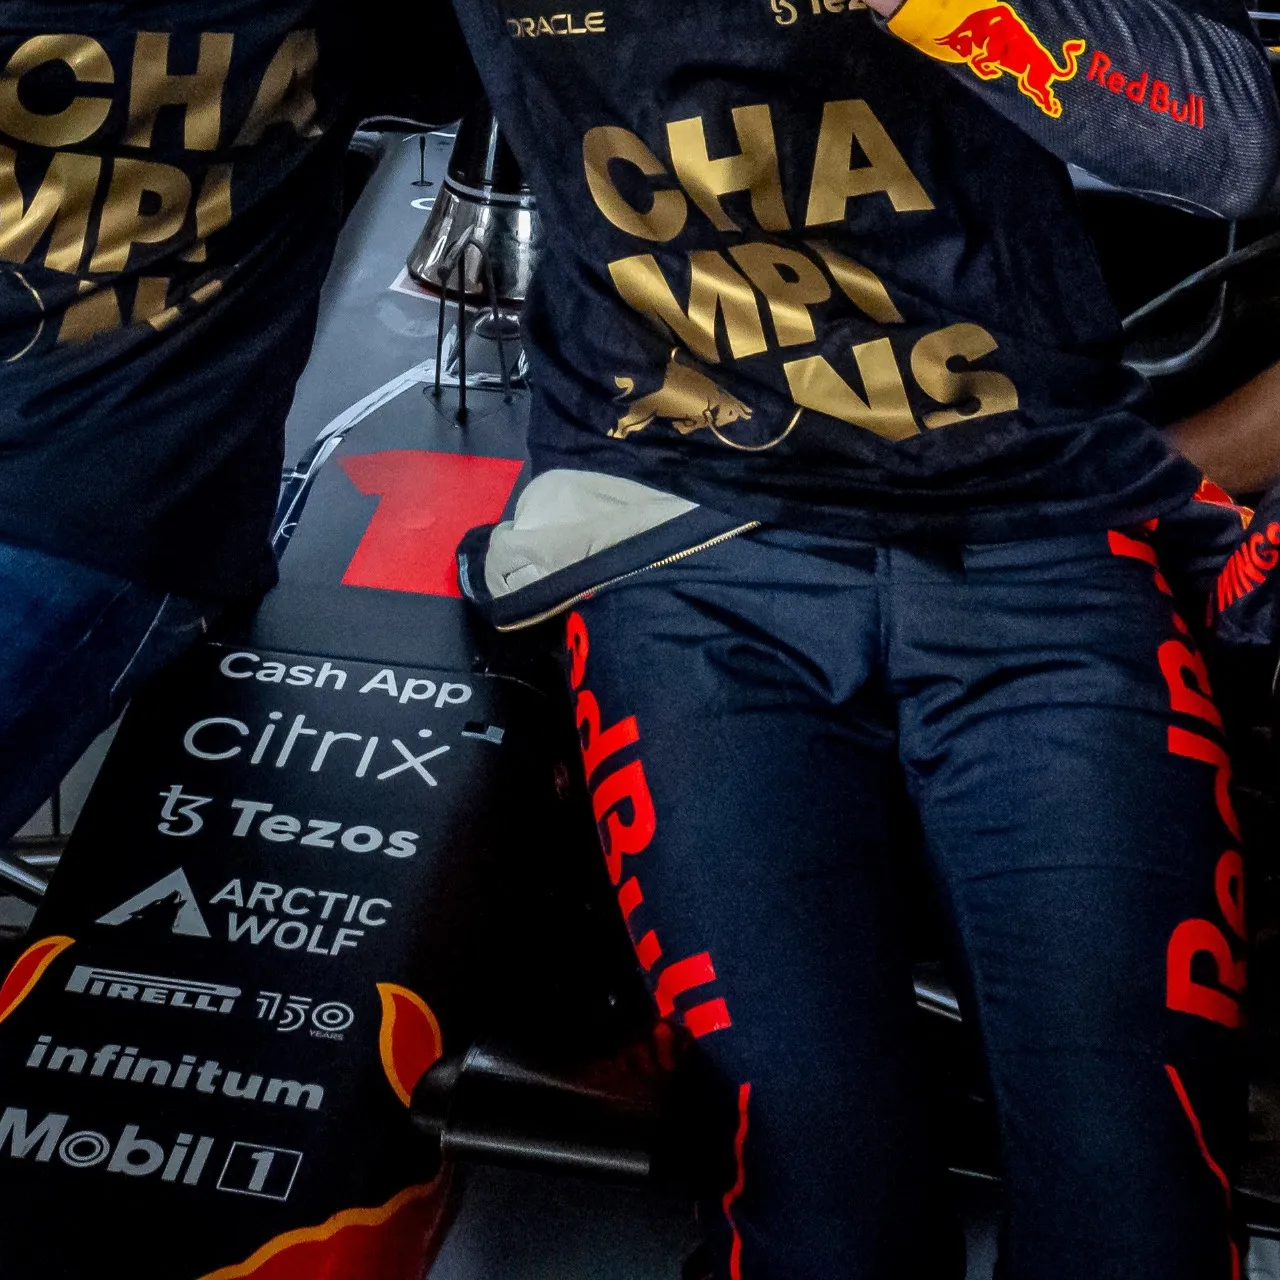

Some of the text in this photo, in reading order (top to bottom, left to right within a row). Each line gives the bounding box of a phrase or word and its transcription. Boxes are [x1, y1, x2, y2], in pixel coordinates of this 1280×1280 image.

[1086, 49, 1205, 129] Red Bull
[582, 98, 936, 244] CHA
[782, 321, 1019, 443] NS
[337, 449, 526, 599] 1
[219, 651, 473, 708] Cash App
[231, 799, 421, 859] Tezos
[209, 878, 393, 927] ARCTIC
[227, 912, 365, 957] WOLF
[64, 964, 355, 1033] PIRELLI 150
[308, 1028, 344, 1042] YEARS
[25, 1035, 325, 1112] infinitum
[247, 1150, 276, 1193] 1
